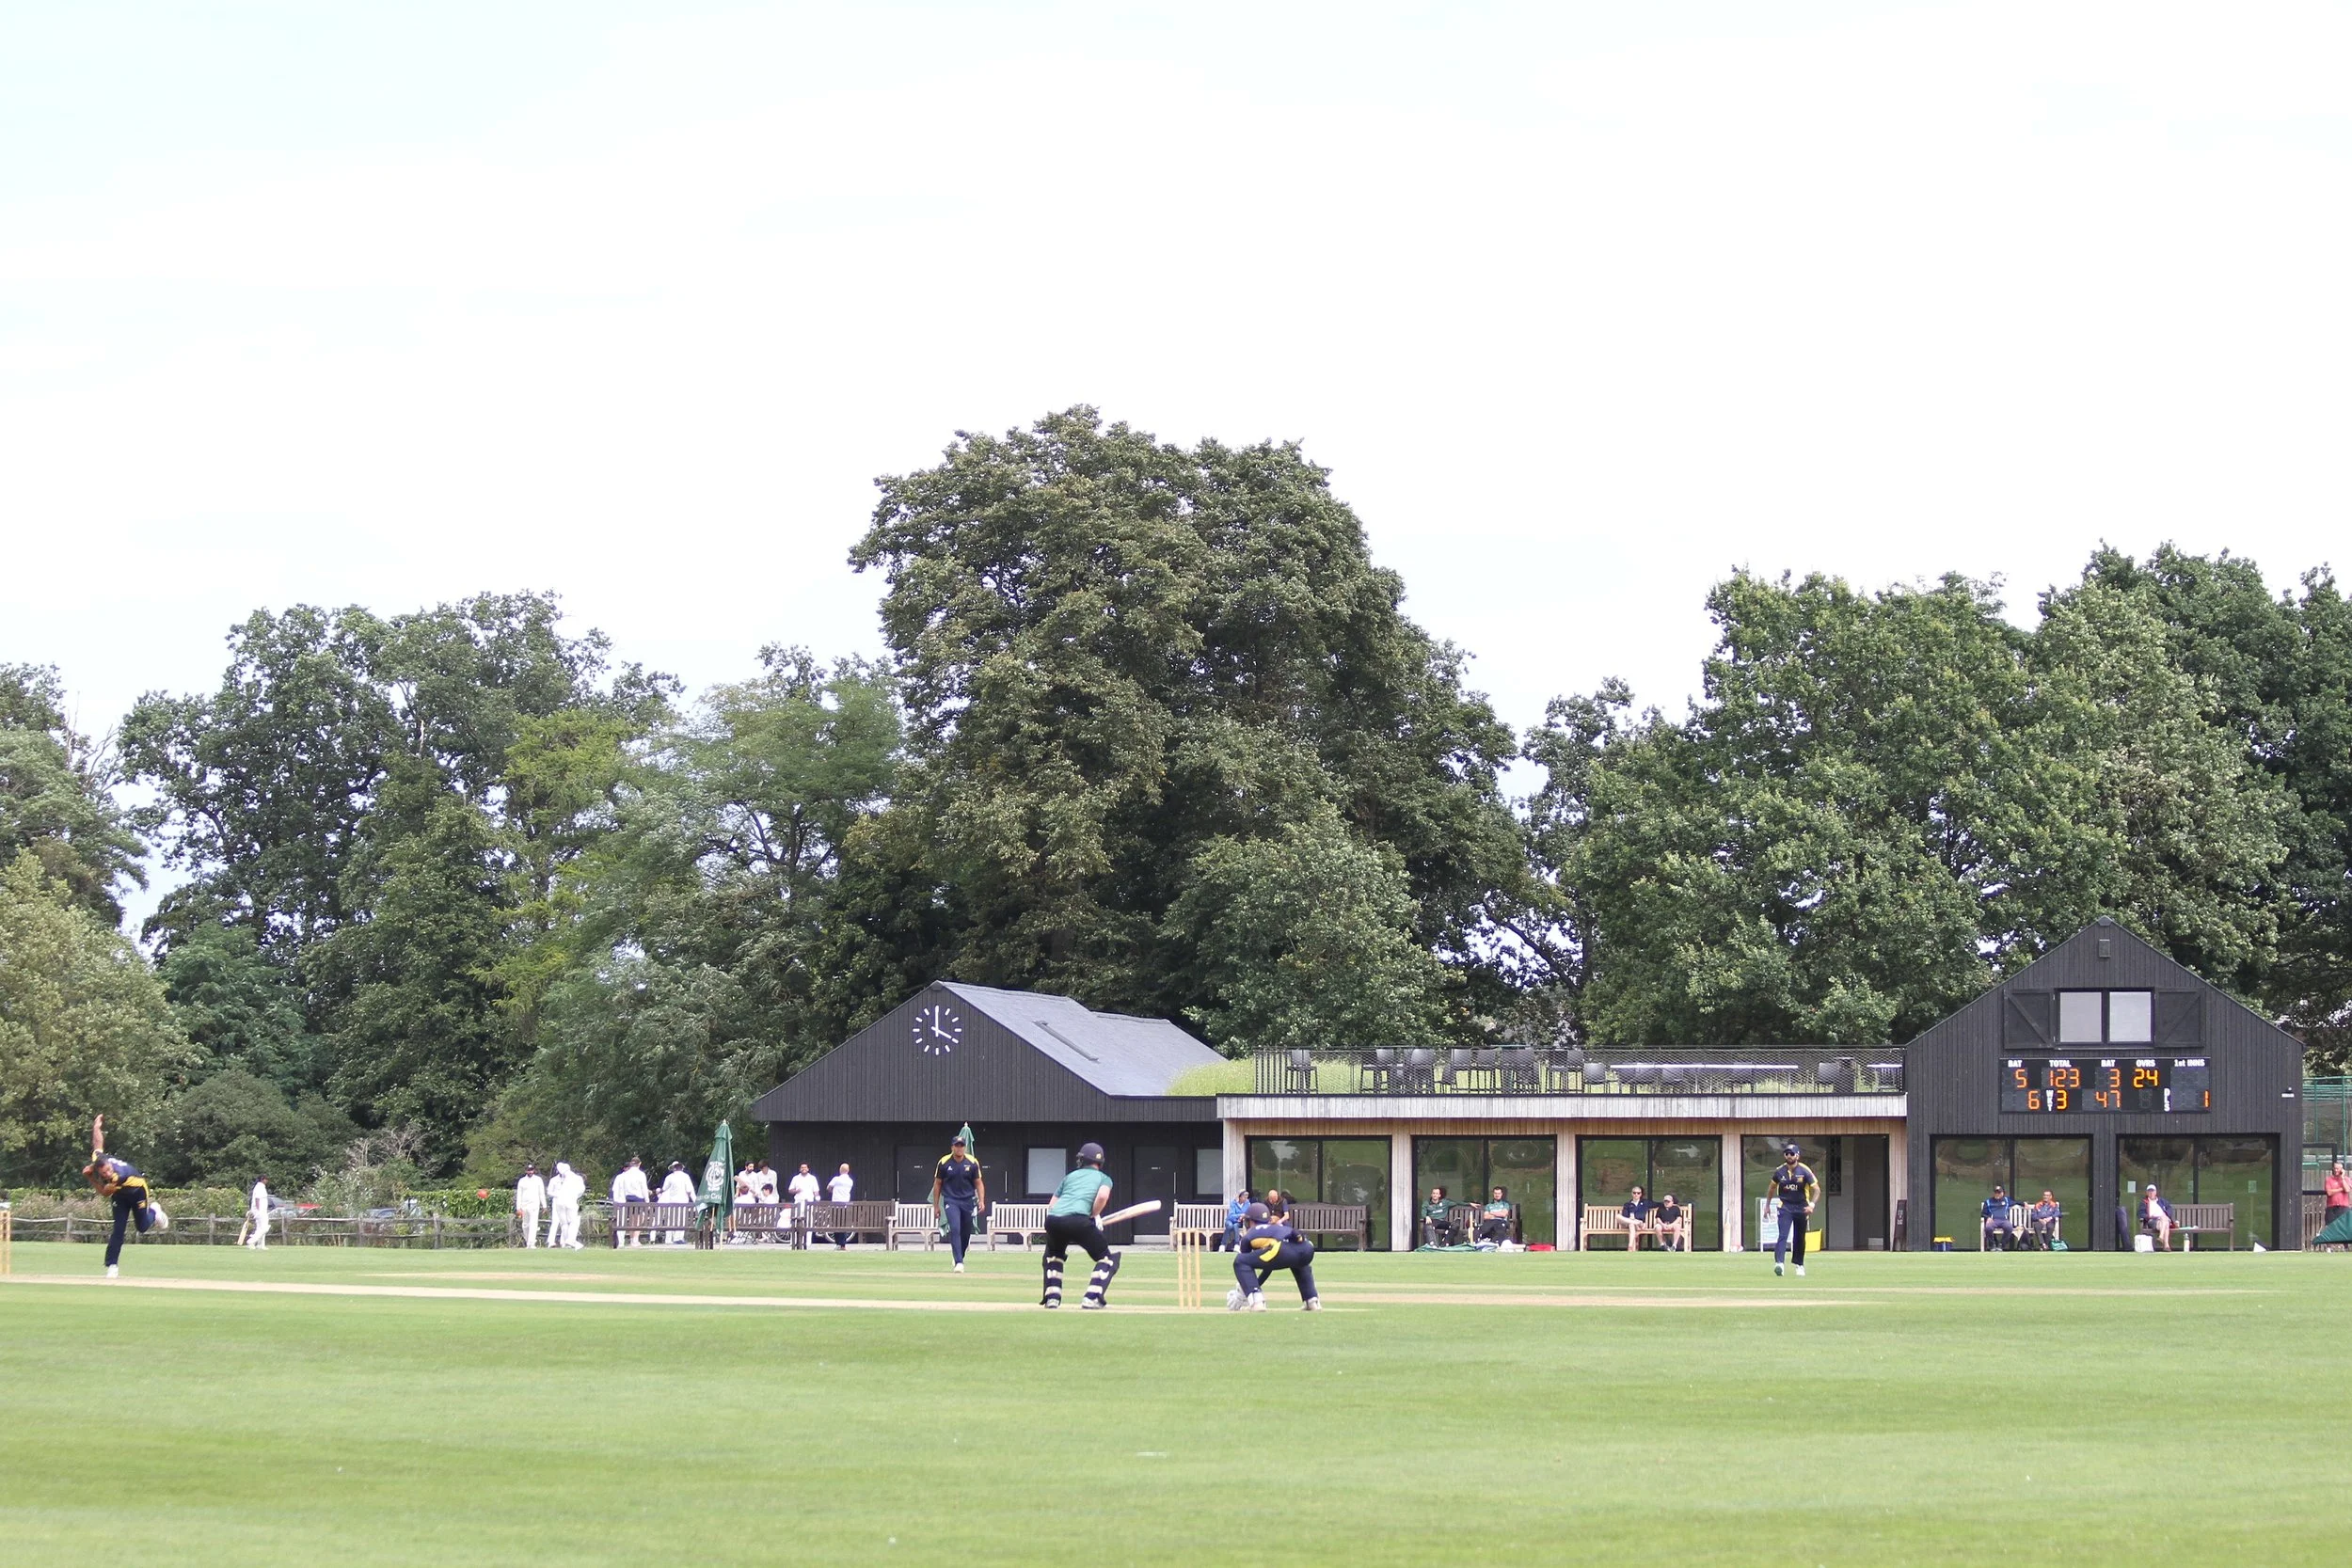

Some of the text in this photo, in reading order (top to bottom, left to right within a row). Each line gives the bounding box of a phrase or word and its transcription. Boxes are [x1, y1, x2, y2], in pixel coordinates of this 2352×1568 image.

[2015, 1069, 2027, 1088] 5
[2049, 1069, 2079, 1087] 123
[2109, 1069, 2120, 1087] 3
[2134, 1069, 2158, 1087] 24
[2028, 1090, 2040, 1109] 6
[2057, 1089, 2067, 1109] 3
[2095, 1089, 2121, 1108] 47
[2204, 1090, 2209, 1108] 1
